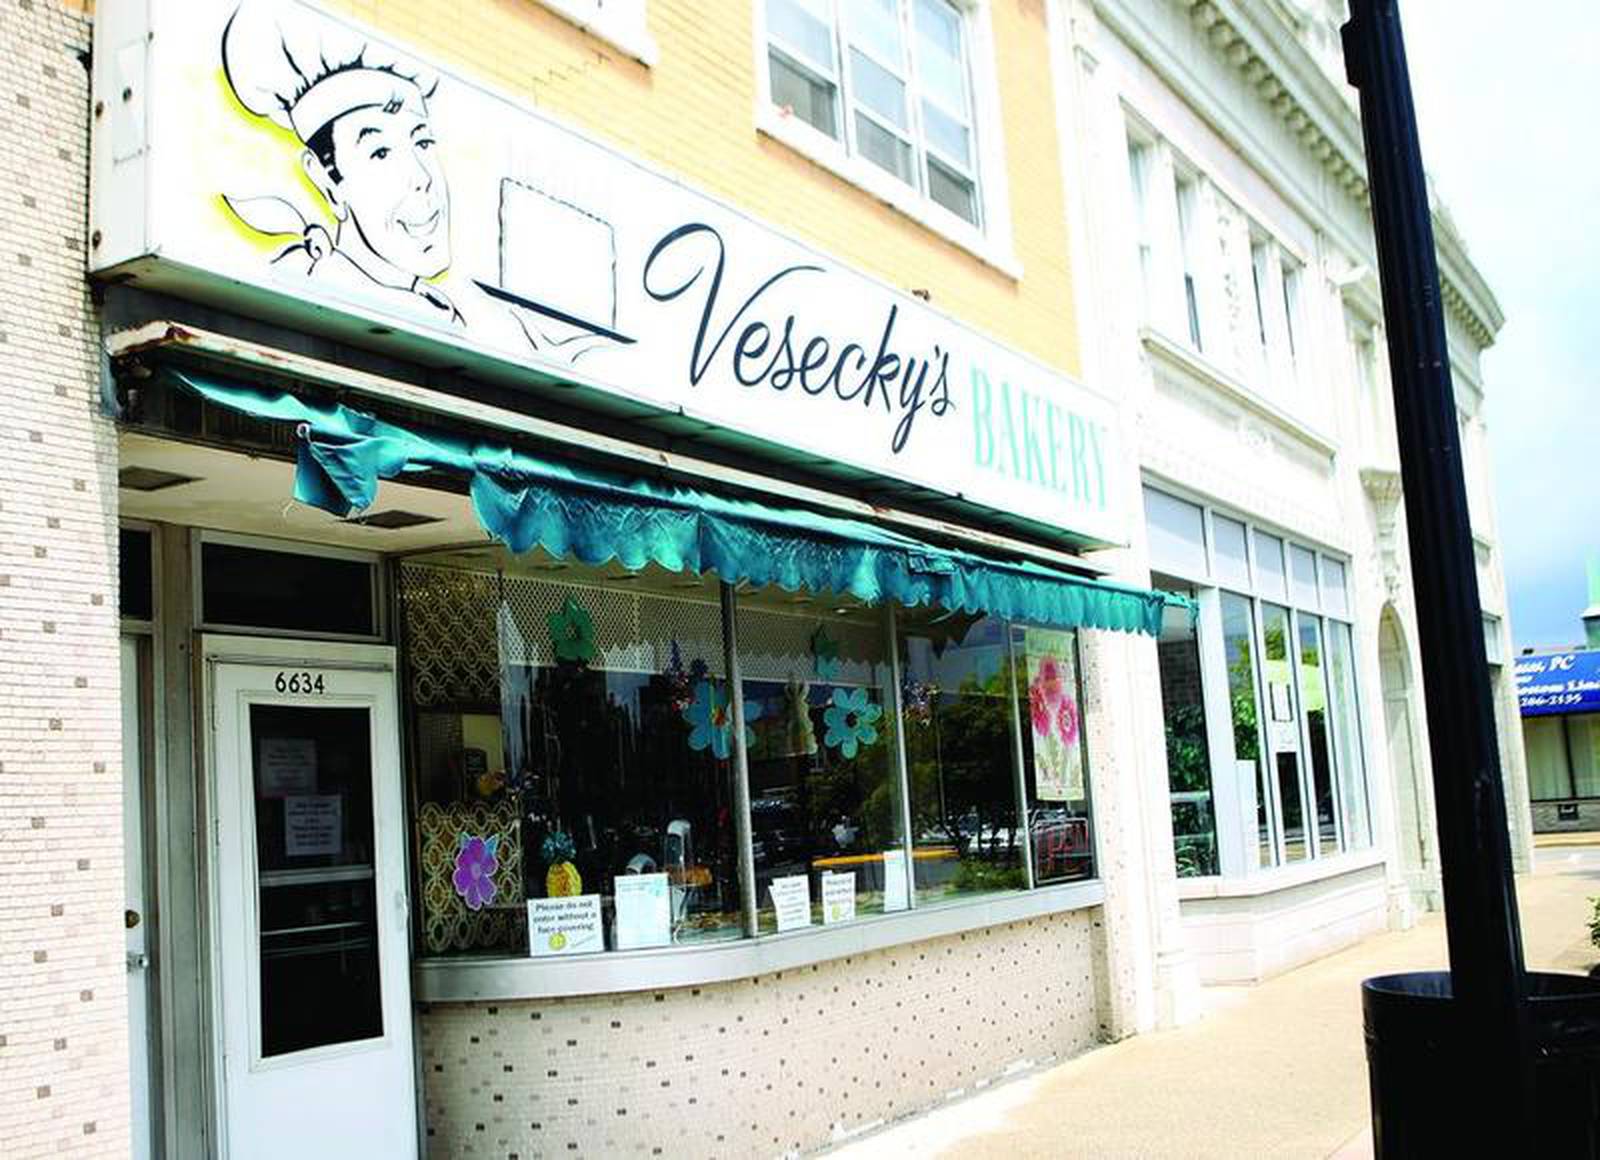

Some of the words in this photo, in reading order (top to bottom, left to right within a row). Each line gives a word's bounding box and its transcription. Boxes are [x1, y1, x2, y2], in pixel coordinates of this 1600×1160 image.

[643, 223, 956, 454] Vesecky's
[970, 361, 1108, 512] BAKERY
[275, 671, 325, 695] 6634
